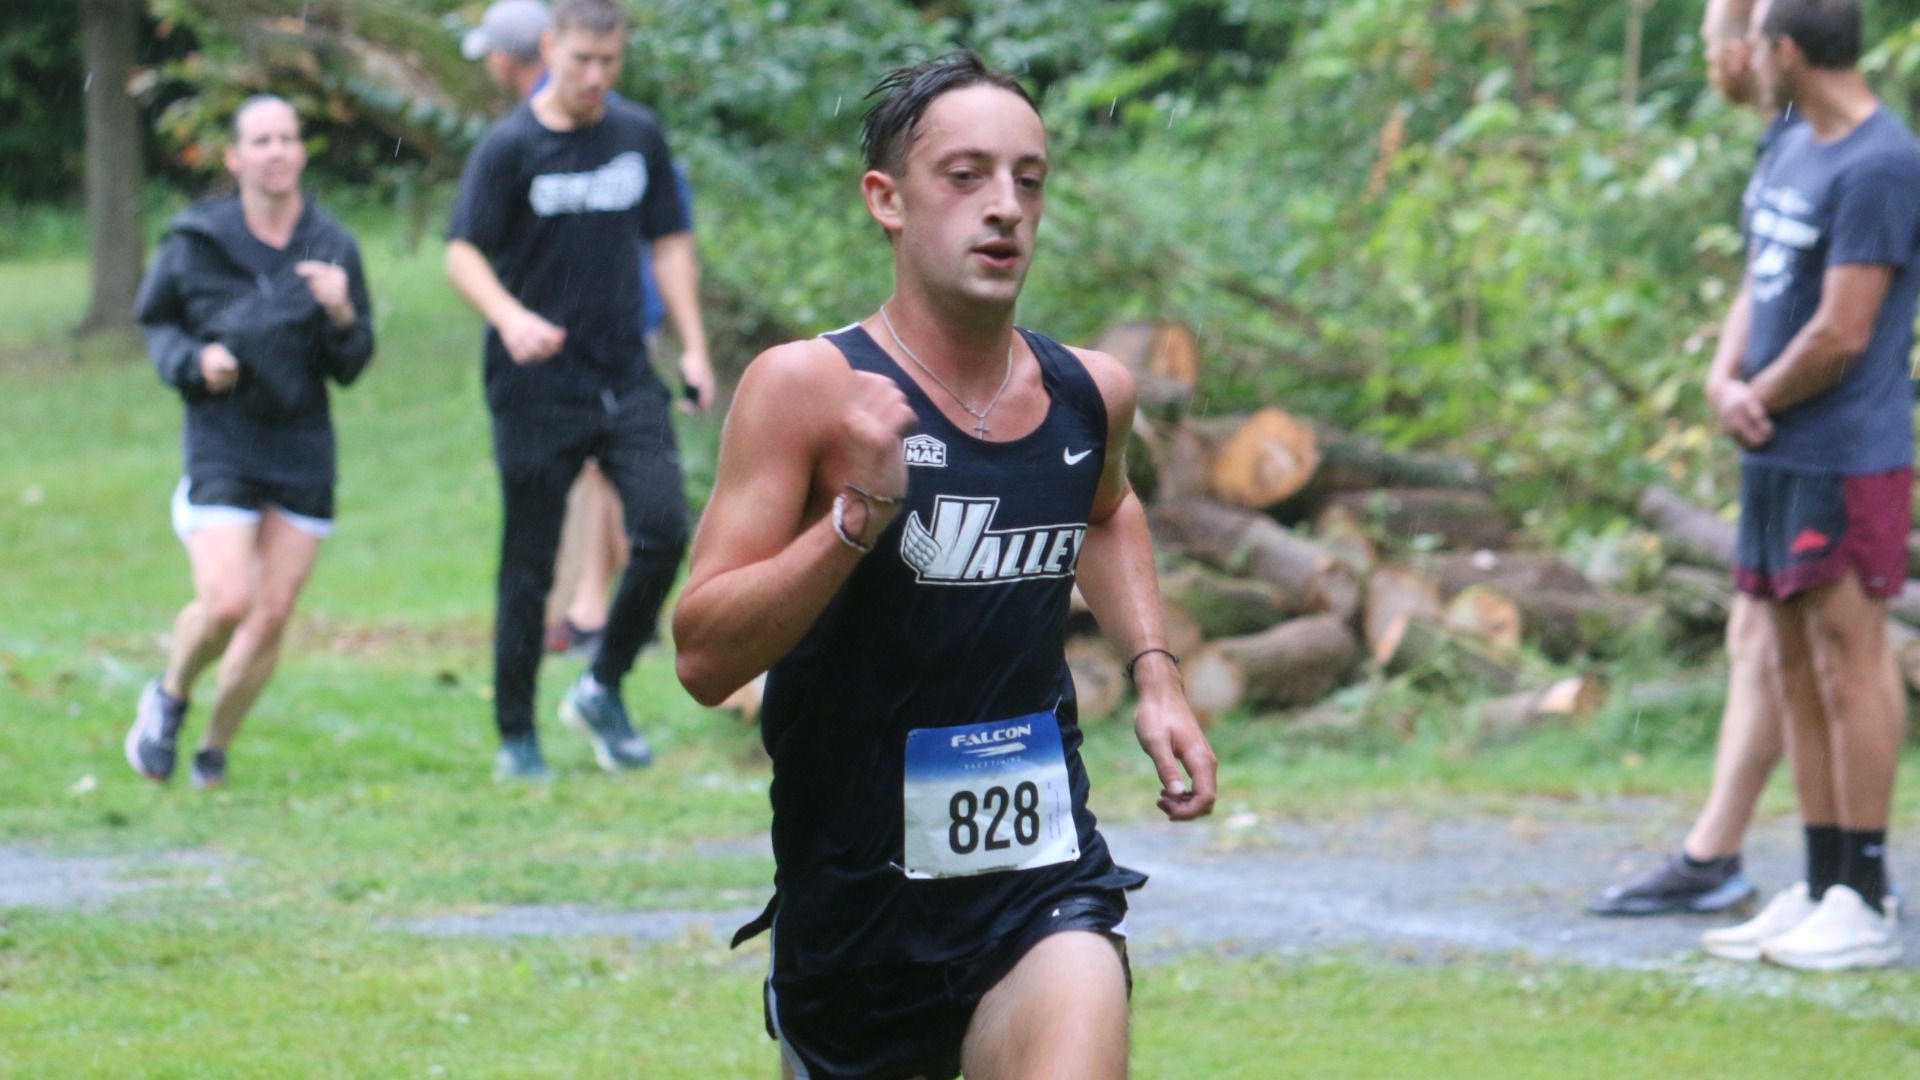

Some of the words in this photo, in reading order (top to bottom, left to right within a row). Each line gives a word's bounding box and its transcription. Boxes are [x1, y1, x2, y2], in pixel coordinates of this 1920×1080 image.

[907, 449, 942, 463] MAC
[923, 500, 1086, 580] VALLEY
[951, 724, 1031, 748] FALCON
[949, 781, 1039, 854] 828
